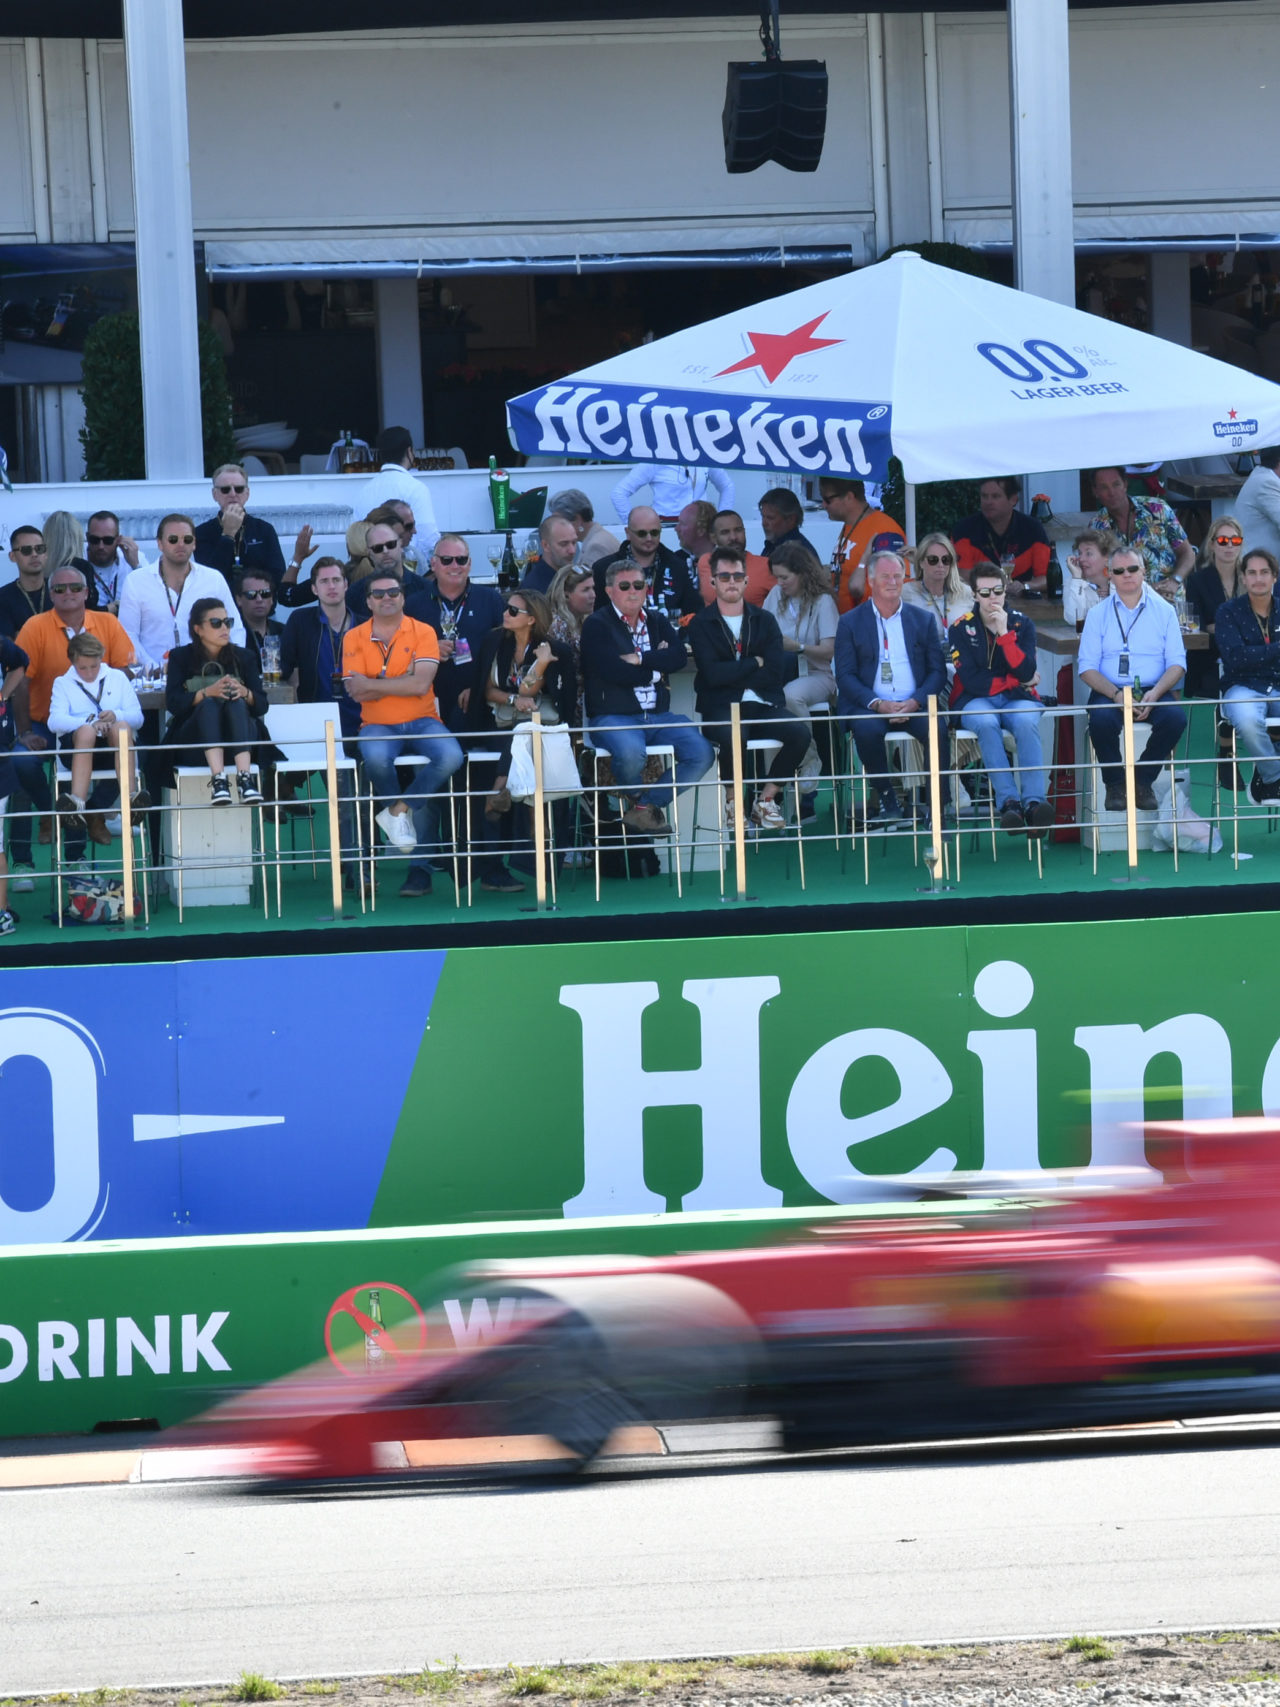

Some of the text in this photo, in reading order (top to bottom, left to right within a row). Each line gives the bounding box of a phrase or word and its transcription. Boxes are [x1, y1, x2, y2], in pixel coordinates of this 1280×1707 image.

[1010, 382, 1129, 400] LAGER BEER
[535, 386, 872, 475] Heineken
[1215, 422, 1256, 434] Heineken
